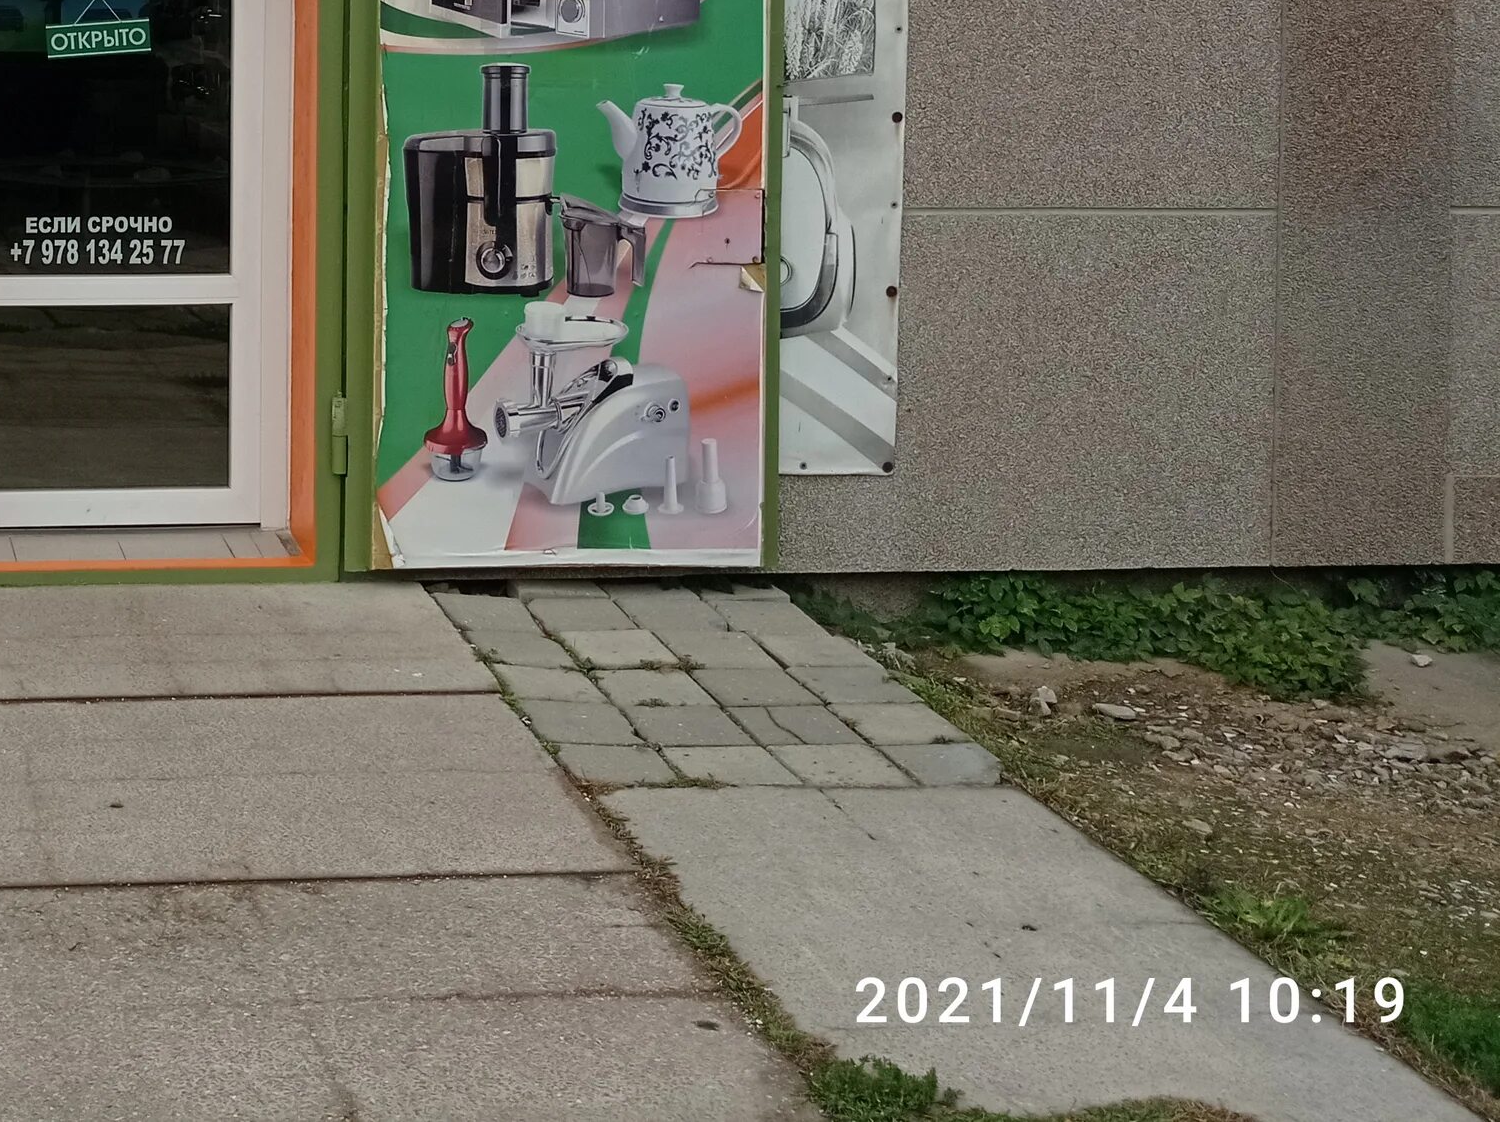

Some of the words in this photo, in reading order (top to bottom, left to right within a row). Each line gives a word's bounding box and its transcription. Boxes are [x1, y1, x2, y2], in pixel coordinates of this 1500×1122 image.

[50, 27, 146, 51] ОТКРЫТО
[25, 216, 81, 234] ЕСЛИ
[87, 216, 173, 233] СРОЧНО
[10, 239, 35, 265] +7
[41, 239, 79, 265] 978
[86, 239, 123, 265] 134
[129, 239, 154, 265] 25
[160, 239, 186, 265] 77
